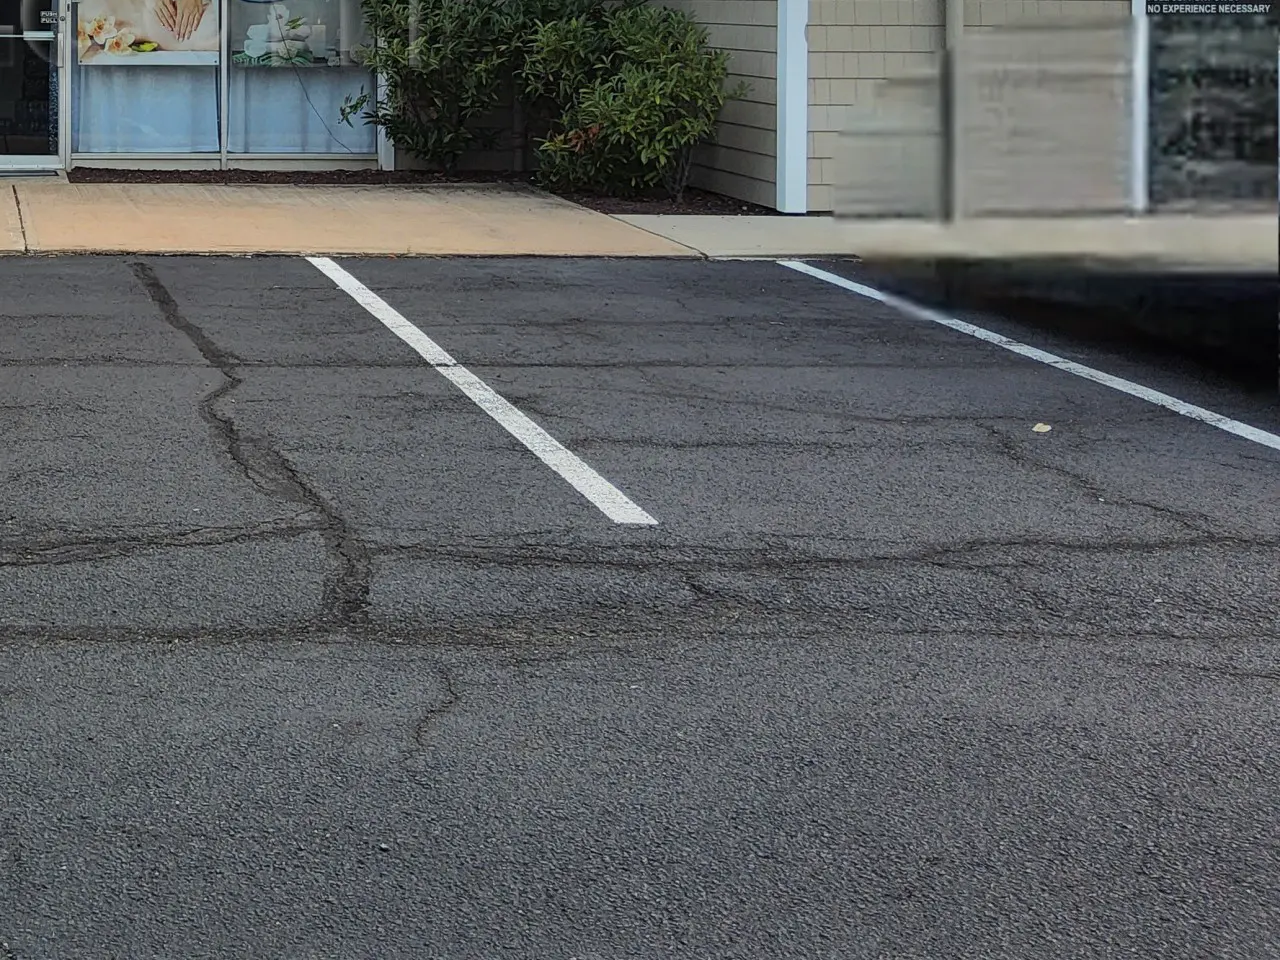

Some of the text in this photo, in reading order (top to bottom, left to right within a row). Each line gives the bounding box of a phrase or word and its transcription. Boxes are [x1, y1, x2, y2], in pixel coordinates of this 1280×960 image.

[1147, 4, 1271, 13] NO EXPERIENCE NECESSARY
